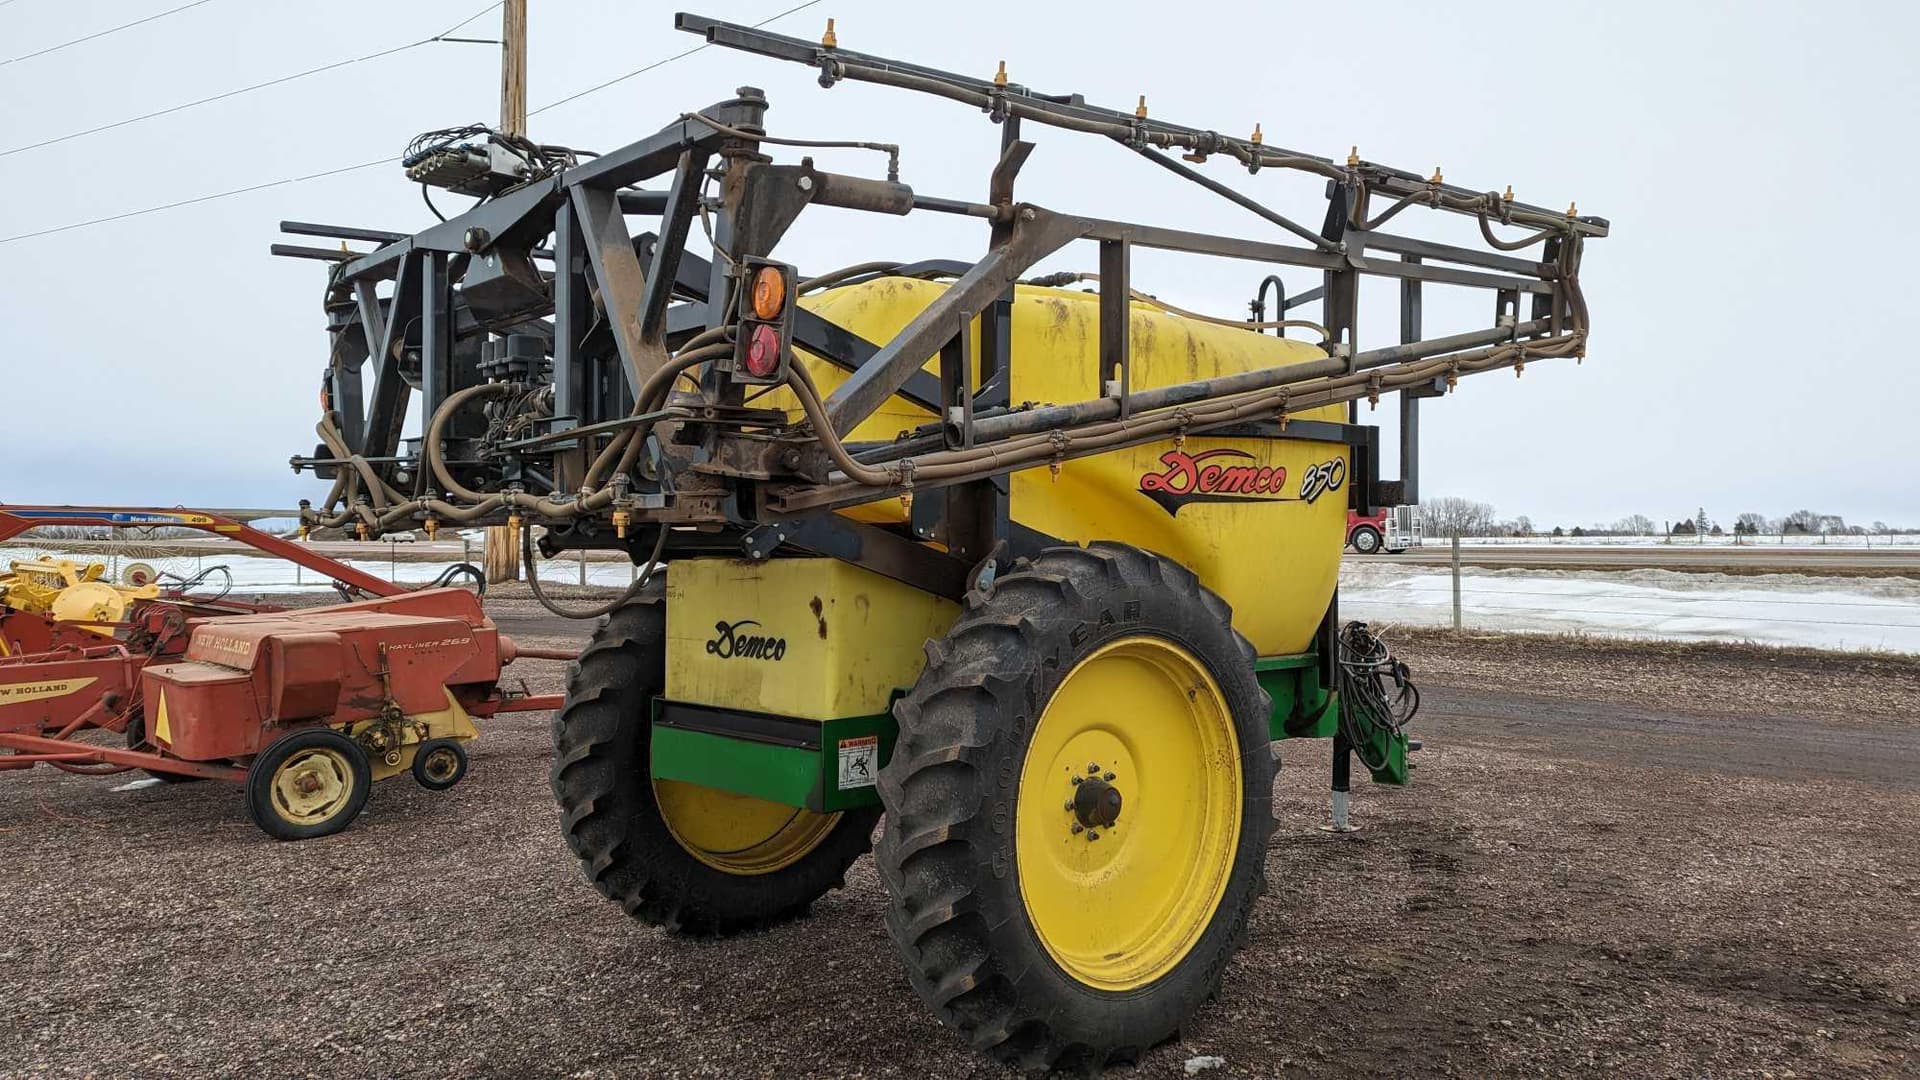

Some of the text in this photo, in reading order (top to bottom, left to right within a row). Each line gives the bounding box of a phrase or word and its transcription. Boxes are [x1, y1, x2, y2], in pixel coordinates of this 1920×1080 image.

[1140, 448, 1346, 504] Demco 850
[148, 516, 175, 524] Holland
[213, 636, 251, 655] HOLLAND
[388, 637, 471, 650] HAYLINER 269
[706, 620, 786, 661] Demco
[16, 683, 68, 695] HOLLAND
